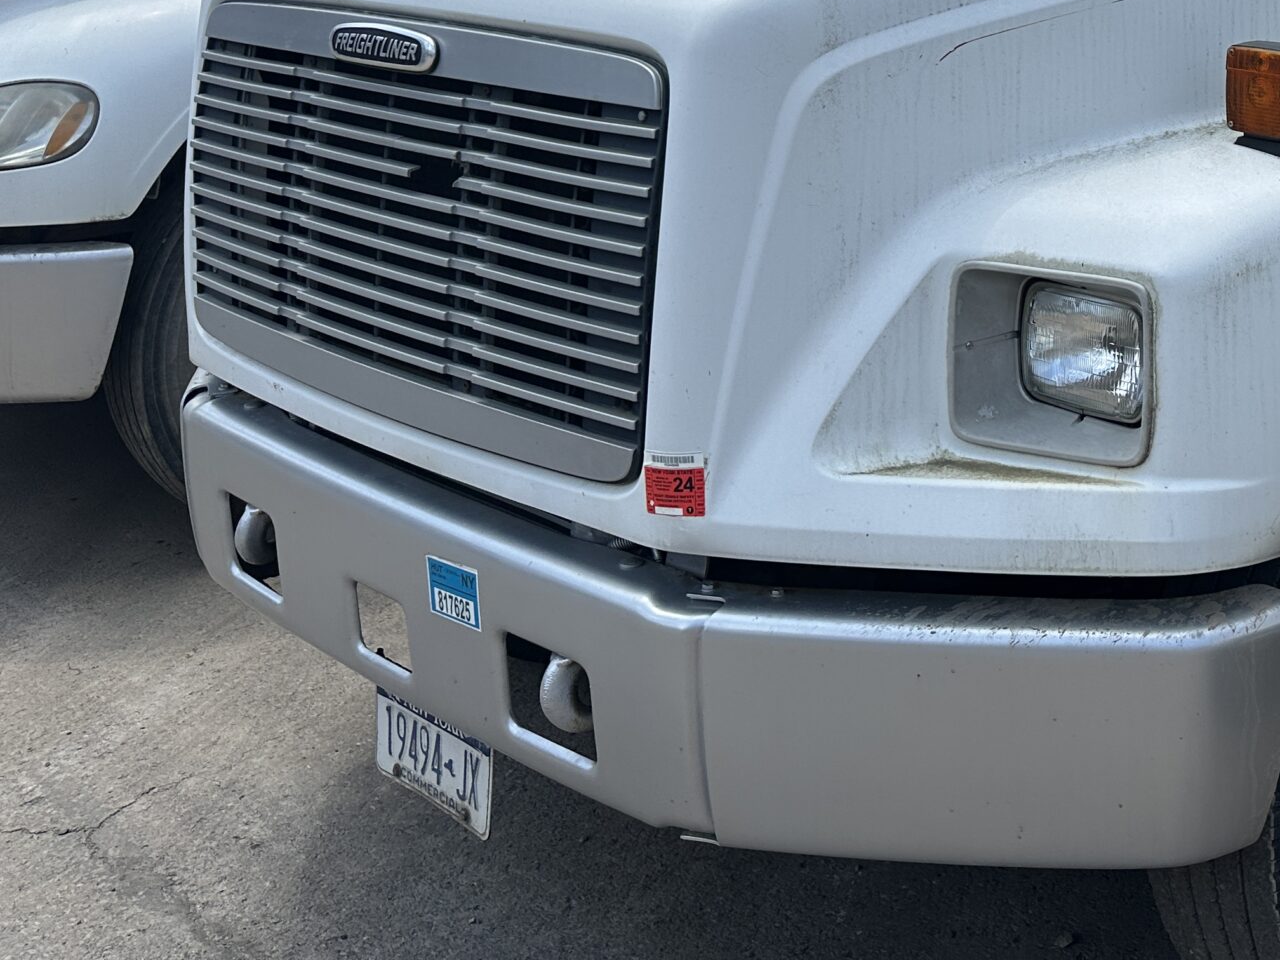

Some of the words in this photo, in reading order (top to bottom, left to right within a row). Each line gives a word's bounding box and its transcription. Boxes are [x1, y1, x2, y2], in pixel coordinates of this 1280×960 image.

[334, 32, 418, 61] FREIGHTLINER
[672, 476, 695, 493] 24
[460, 573, 475, 590] NY
[437, 590, 471, 621] 817625
[401, 767, 463, 813] COMMERCIAL
